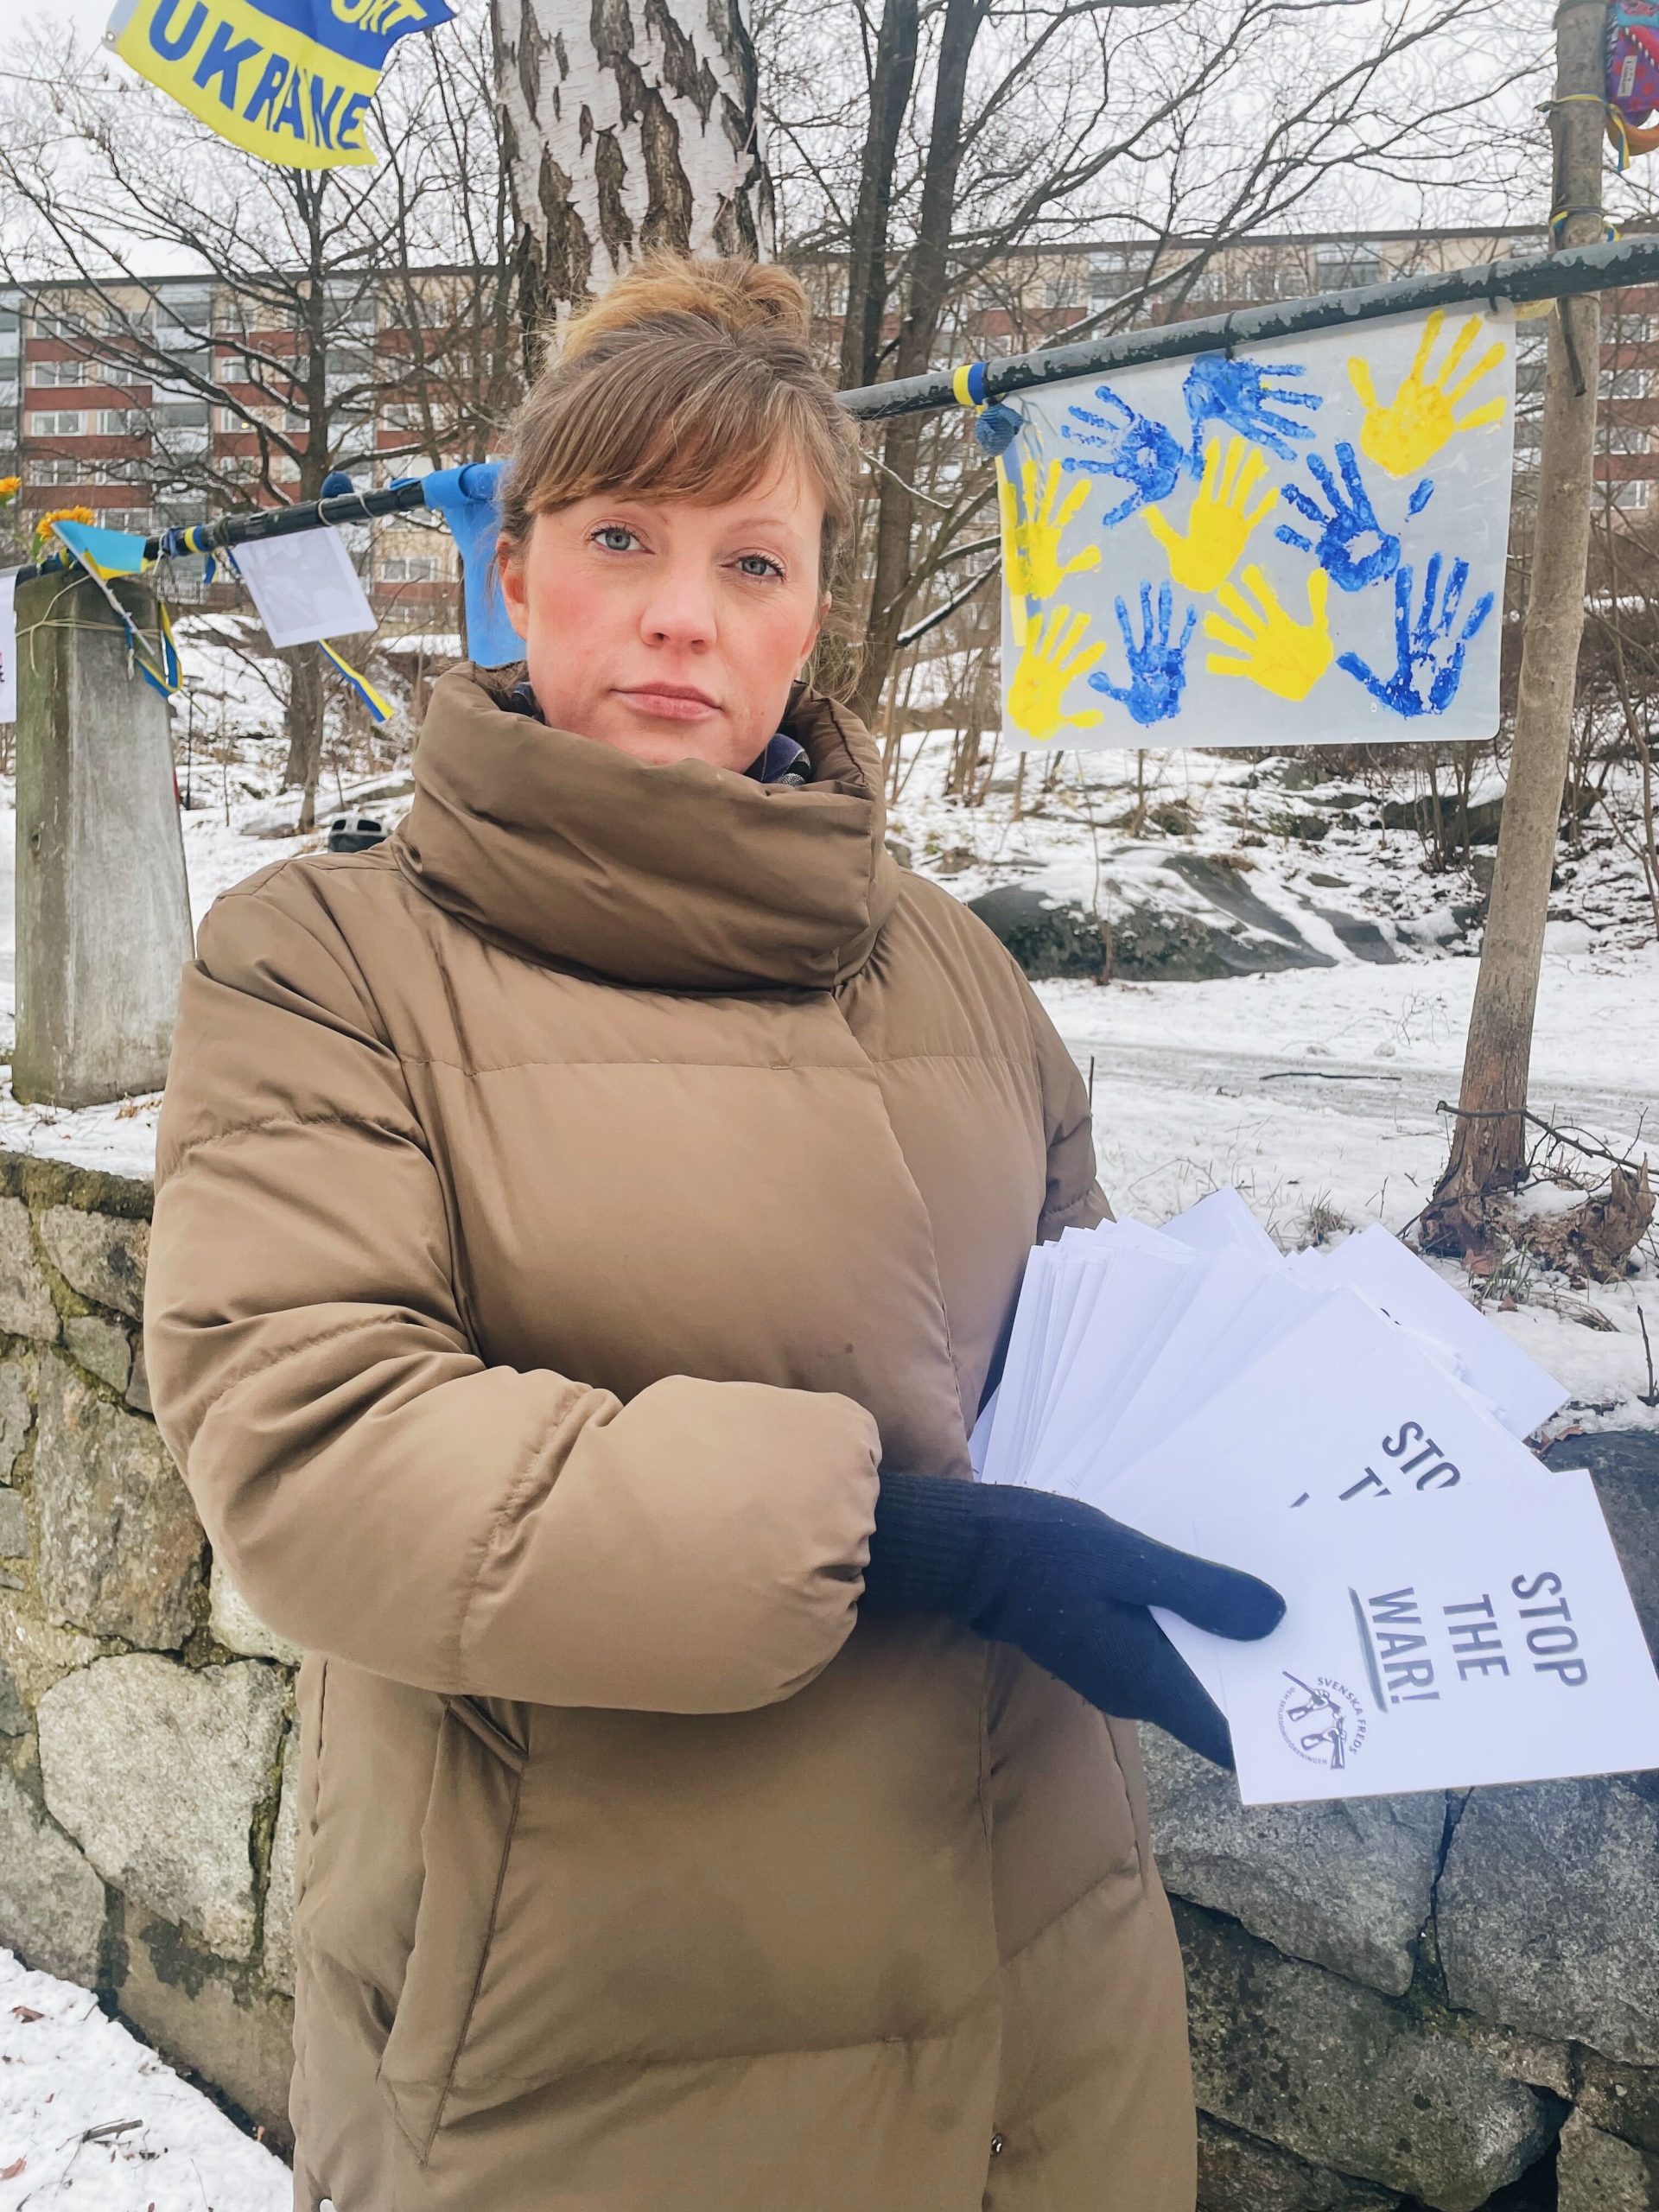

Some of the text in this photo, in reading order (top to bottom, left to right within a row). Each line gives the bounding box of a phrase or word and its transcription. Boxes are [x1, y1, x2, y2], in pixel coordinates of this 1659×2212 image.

[1382, 1421, 1460, 1491] STO
[1368, 1587, 1440, 1704] WAR!
[1443, 1594, 1510, 1681] THE
[1511, 1572, 1588, 1687] STOP
[1318, 1677, 1366, 1754] SVENSKA FREDS
